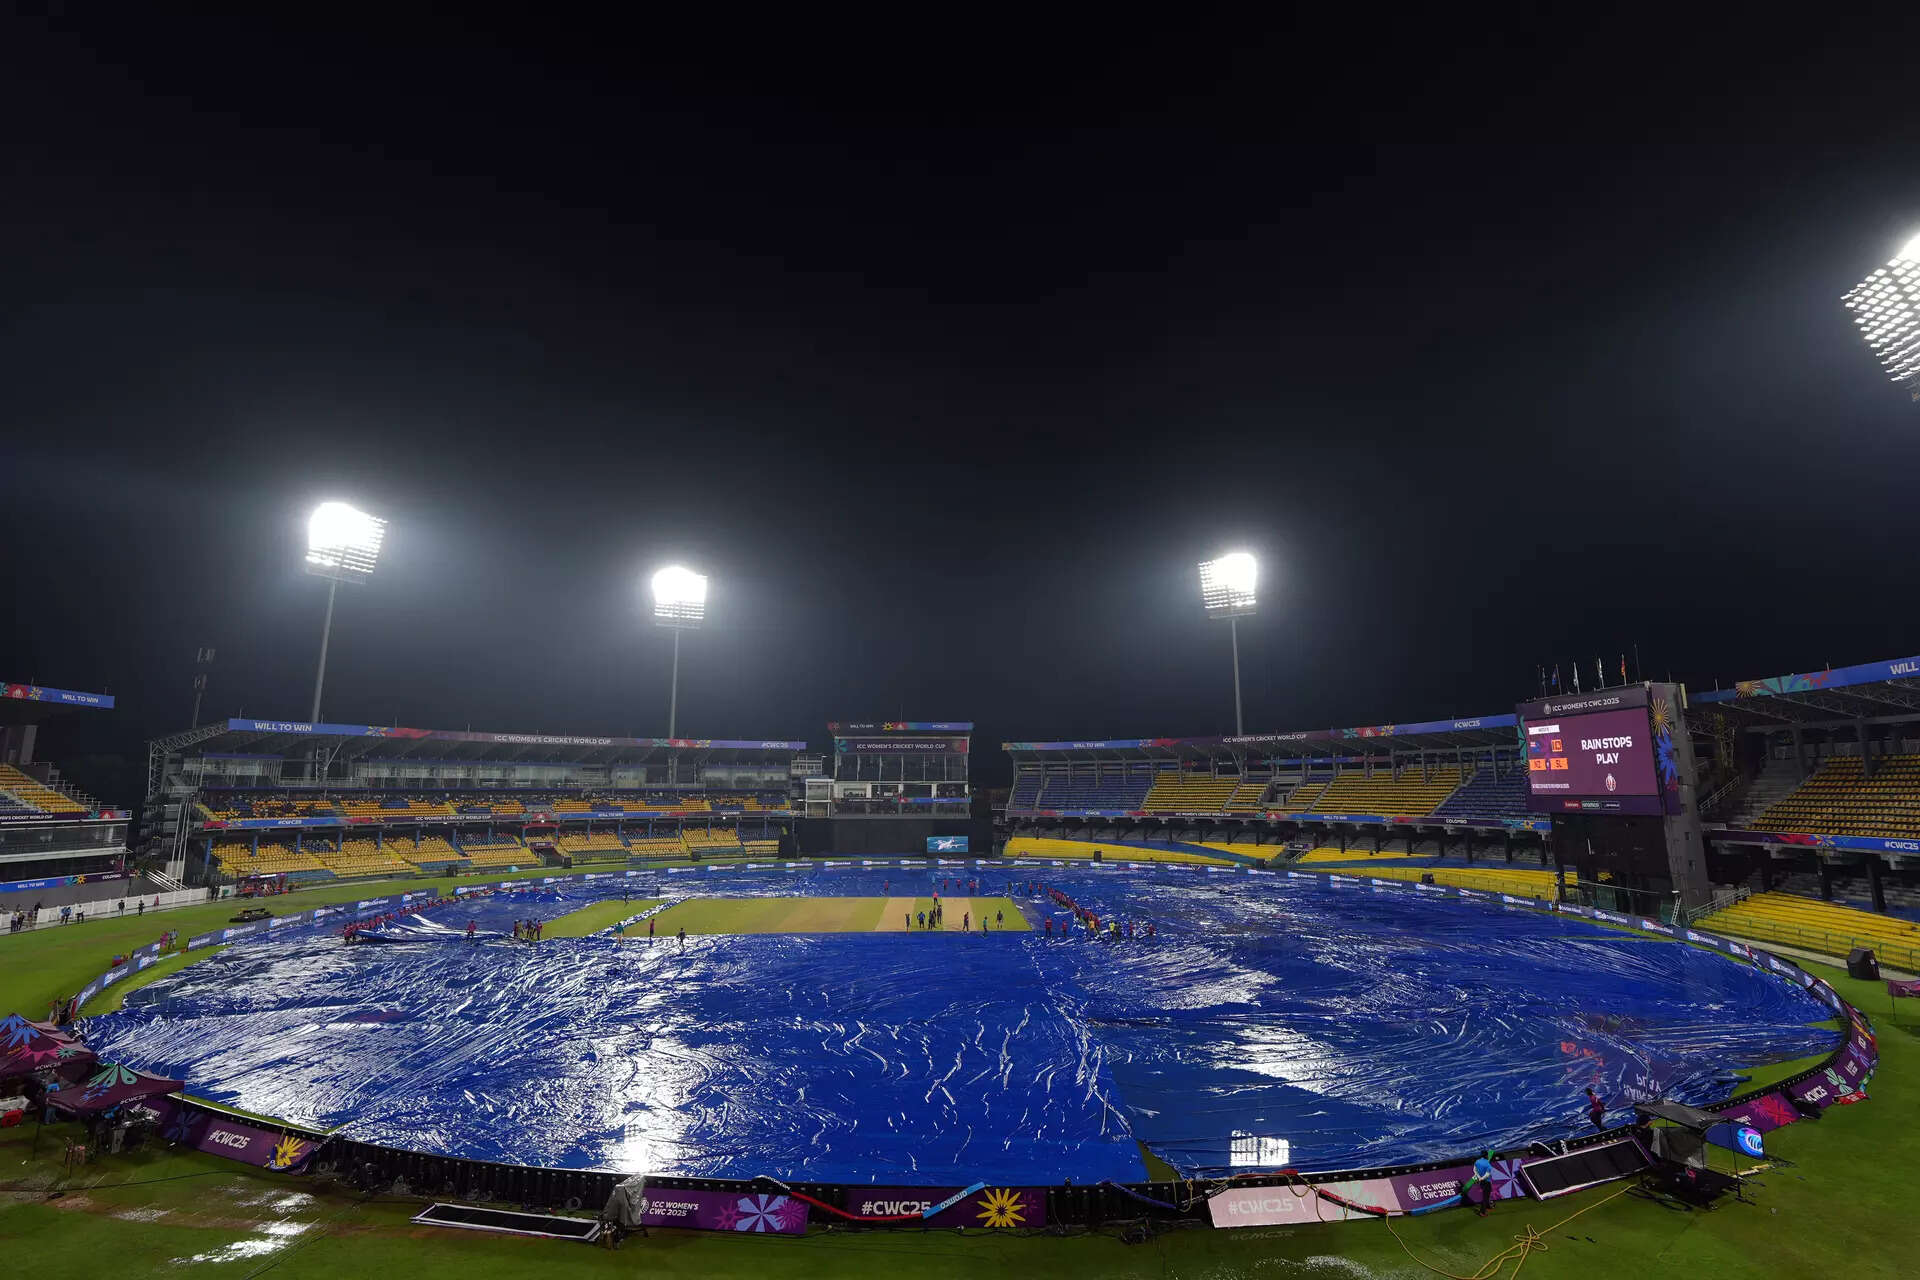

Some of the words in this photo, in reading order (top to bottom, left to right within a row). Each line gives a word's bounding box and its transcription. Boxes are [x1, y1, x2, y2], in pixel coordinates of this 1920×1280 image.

[1890, 662, 1919, 674] WILL
[1562, 702, 1588, 710] WOMEN'S
[255, 722, 277, 730] WILL
[1454, 720, 1480, 728] #CWC25
[1581, 738, 1602, 750] RAIN
[1603, 736, 1632, 748] STOPS
[1596, 753, 1619, 764] PLAY
[1885, 841, 1919, 850] #CWC25
[208, 1129, 251, 1149] #CWC25
[1420, 1184, 1432, 1192] ICC
[1423, 1191, 1439, 1200] CWC
[1438, 1188, 1456, 1198] 2025
[665, 1201, 699, 1210] WOMEN'S
[861, 1200, 931, 1215] #CWC25
[1228, 1199, 1294, 1215] #CWC25
[650, 1208, 667, 1216] CWC
[667, 1209, 687, 1217] 2025
